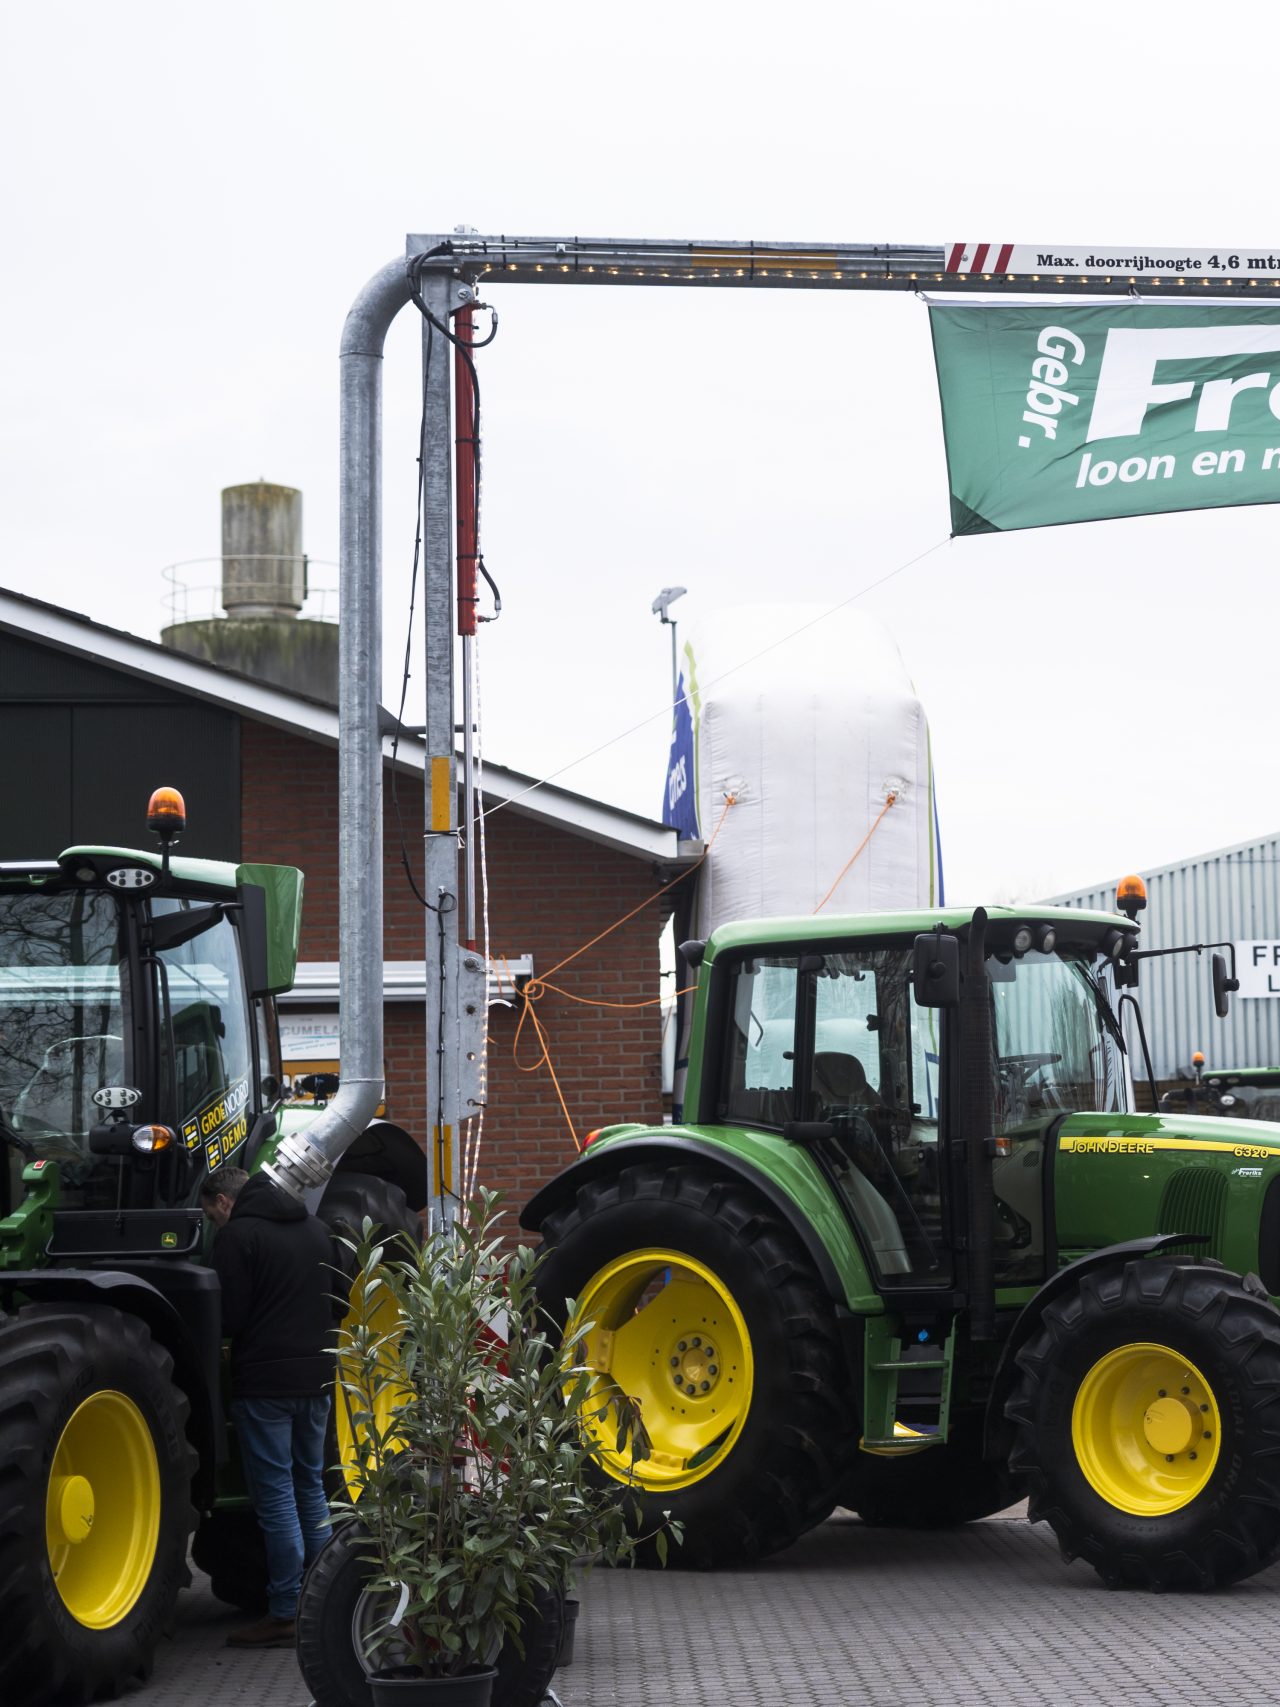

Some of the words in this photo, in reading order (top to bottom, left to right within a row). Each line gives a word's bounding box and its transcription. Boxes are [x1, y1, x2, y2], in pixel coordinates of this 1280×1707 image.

[1037, 254, 1079, 268] Max.
[1085, 256, 1202, 273] doorrijhoogte
[1207, 255, 1240, 271] 4,6
[1018, 326, 1086, 448] Gebr.
[1075, 453, 1175, 488] loon
[1192, 449, 1246, 476] en
[222, 1118, 247, 1154] DEMO
[1069, 1140, 1107, 1154] JOHN
[1107, 1140, 1154, 1154] DEERE
[1233, 1146, 1270, 1159] 6320
